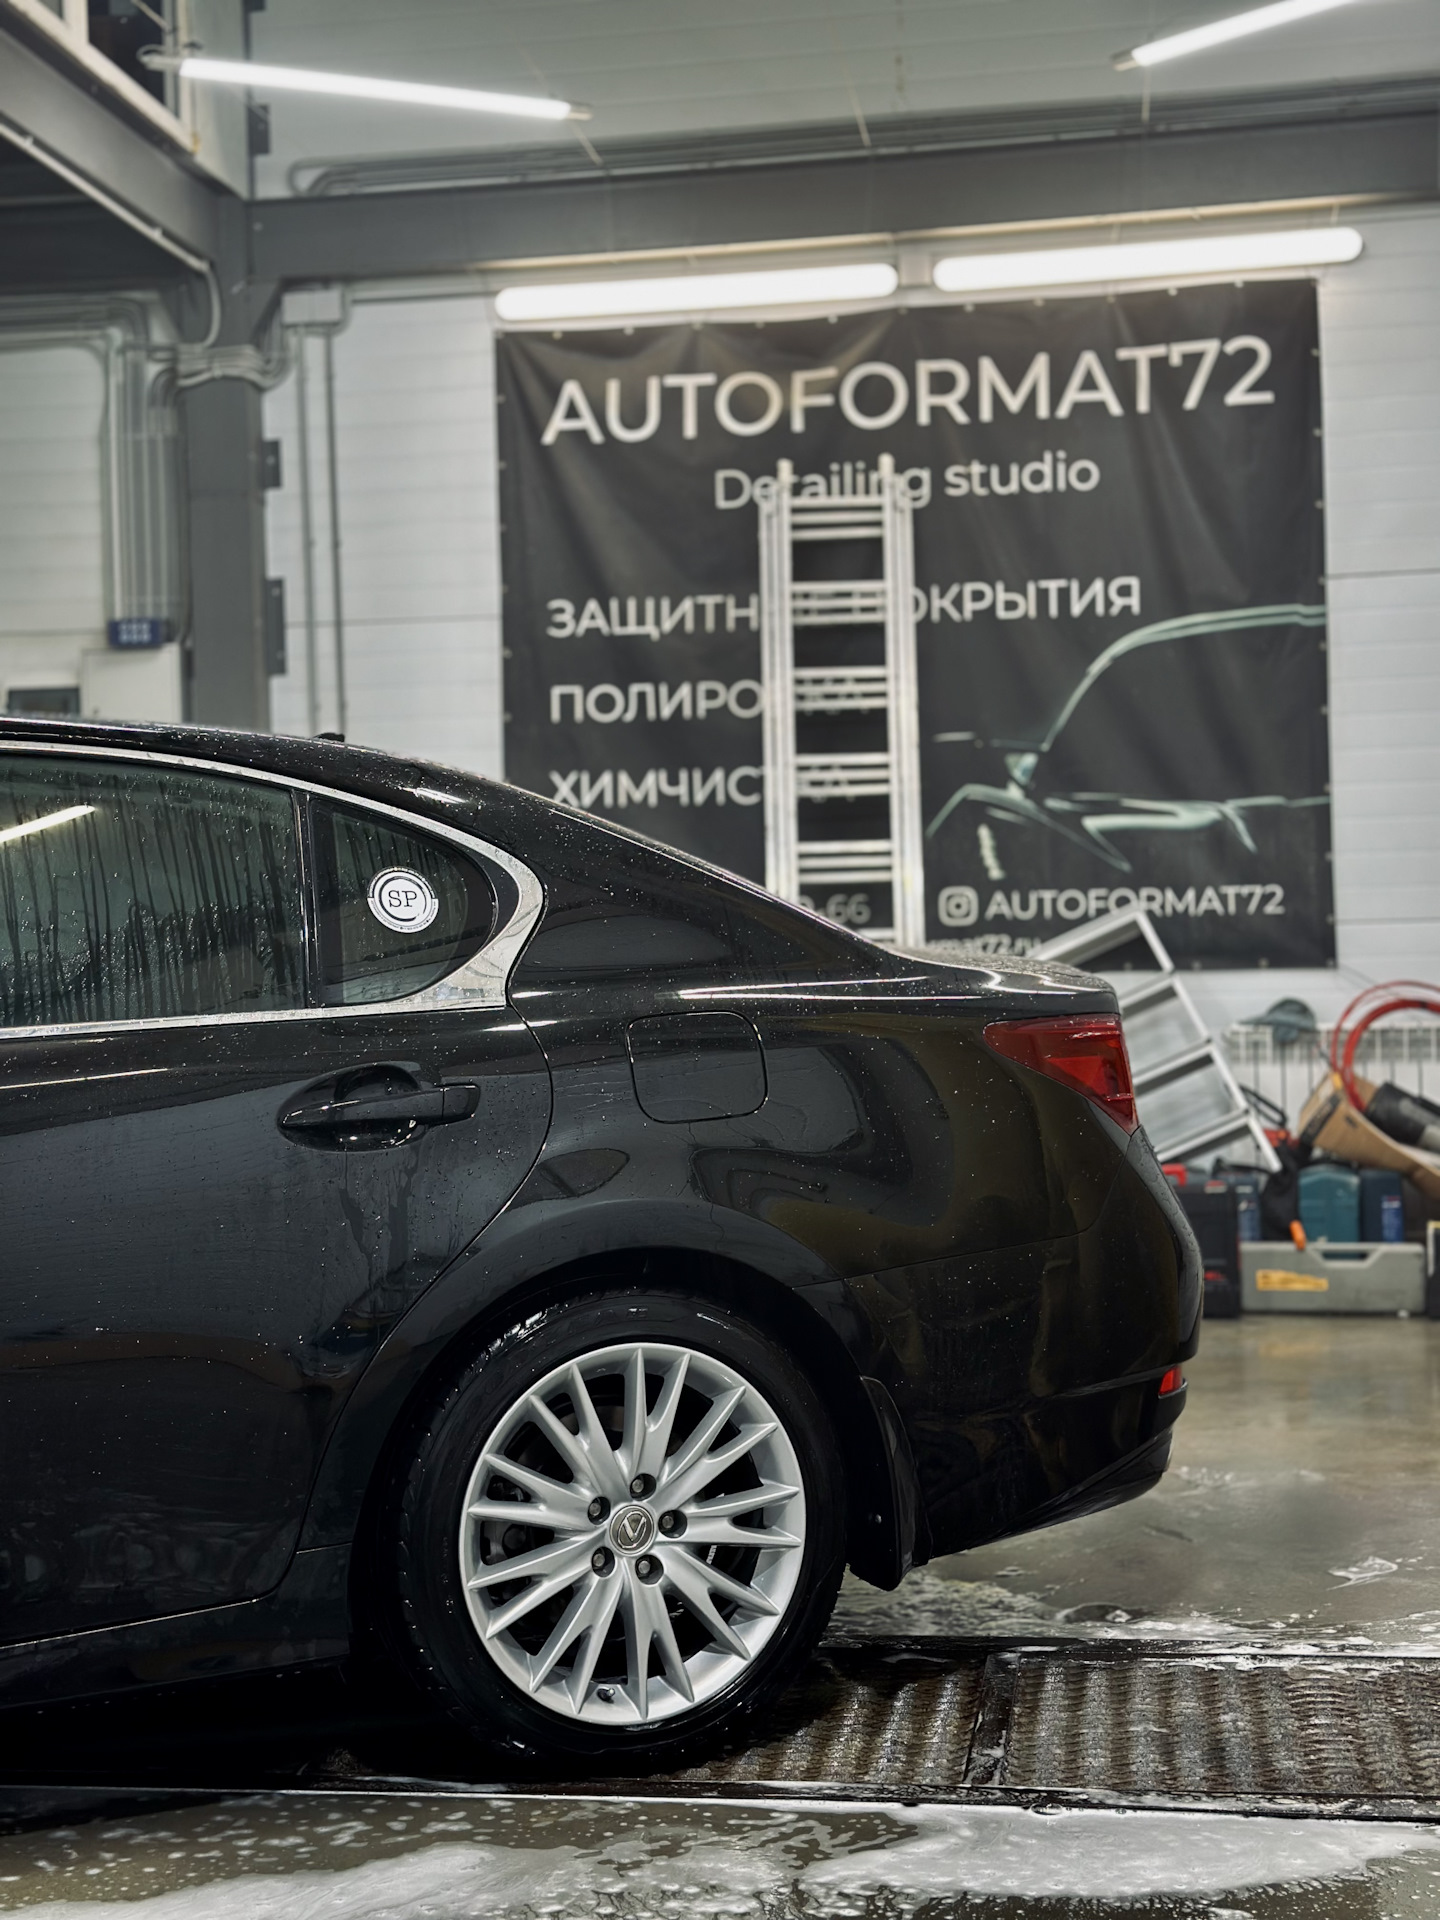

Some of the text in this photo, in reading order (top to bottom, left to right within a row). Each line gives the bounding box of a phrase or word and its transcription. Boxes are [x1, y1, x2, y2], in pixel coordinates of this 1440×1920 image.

[540, 335, 1275, 445] AUTOFORMAT72
[944, 449, 1101, 497] studio
[388, 889, 418, 908] SP
[984, 883, 1286, 921] AUTOFORMAT72
